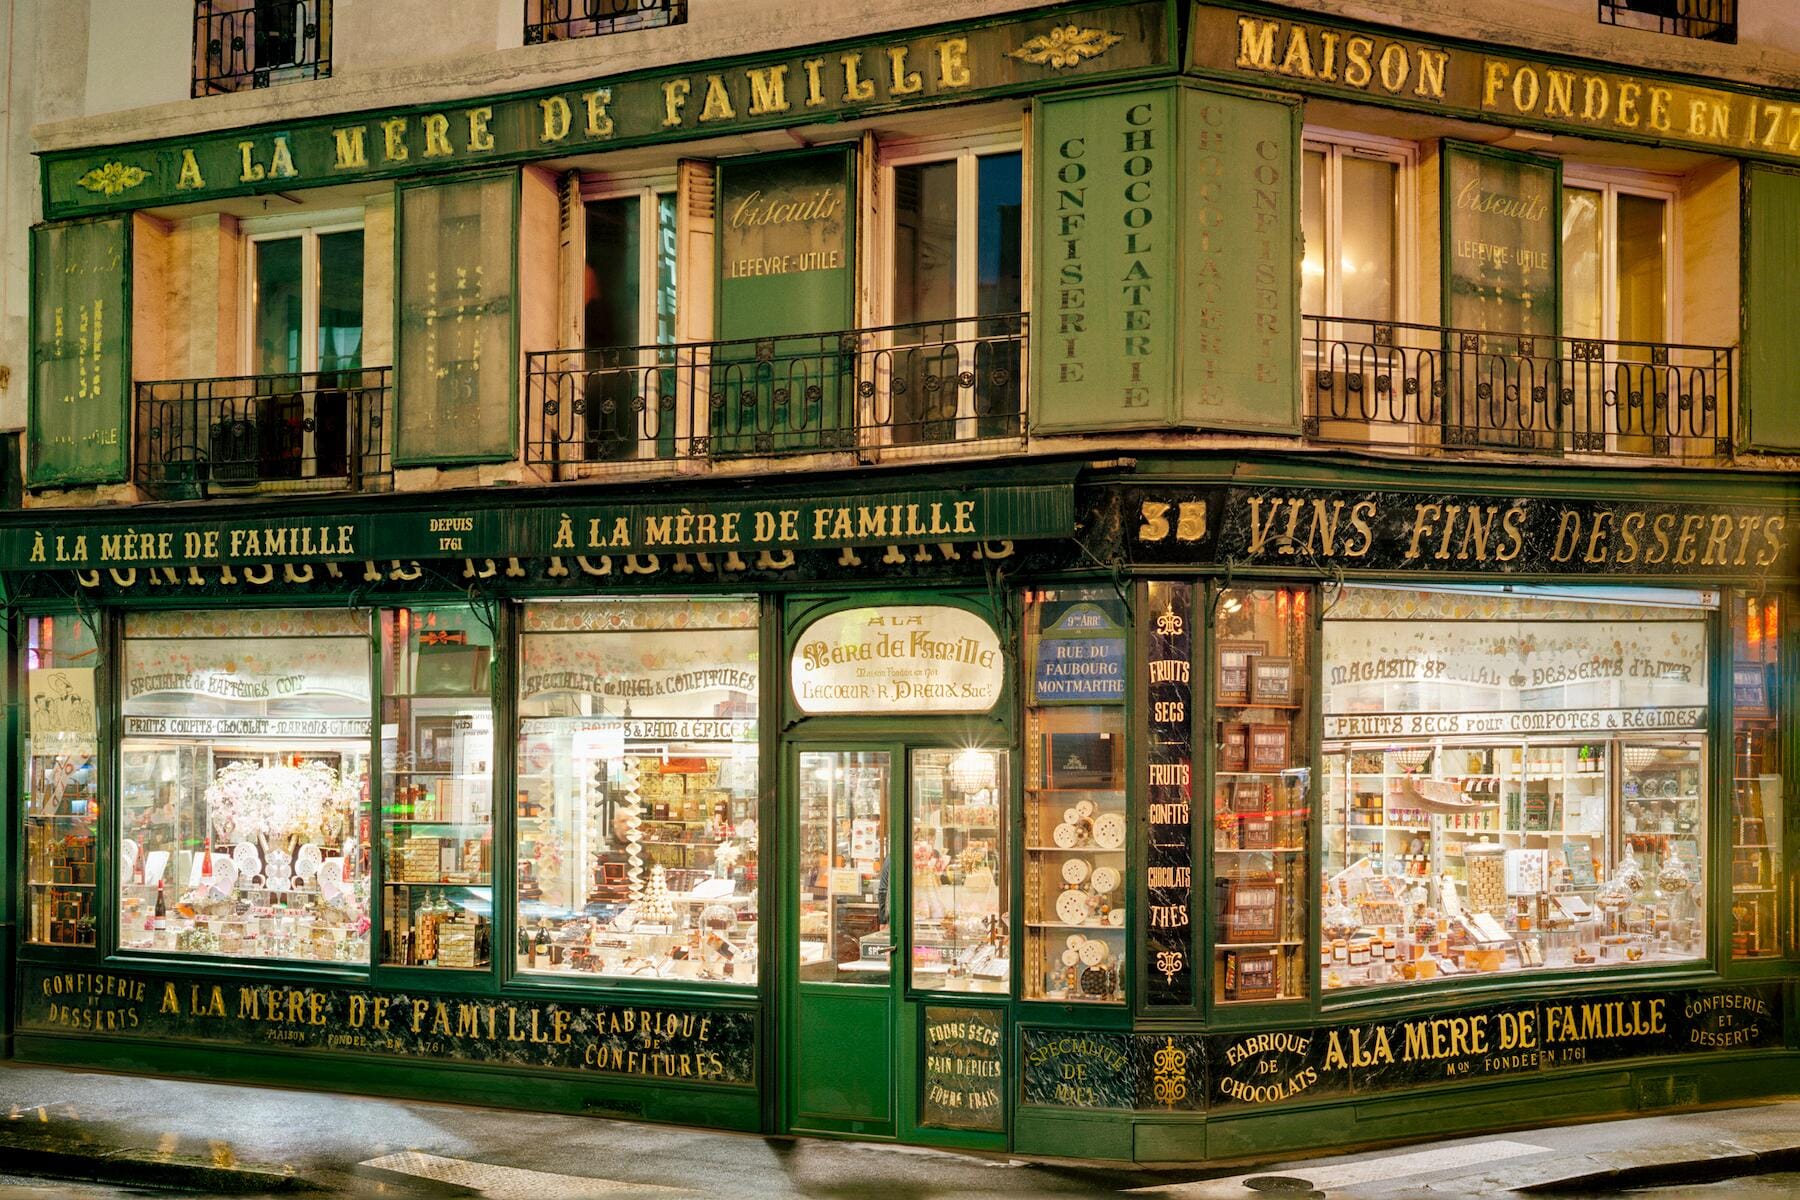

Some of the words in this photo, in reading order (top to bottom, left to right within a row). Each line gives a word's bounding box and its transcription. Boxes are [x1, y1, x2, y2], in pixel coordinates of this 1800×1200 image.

[1236, 17, 1449, 98] MAISON
[1688, 101, 1729, 138] EN
[176, 149, 205, 190] A
[239, 137, 298, 183] LA
[540, 88, 614, 143] DE
[662, 37, 970, 127] FAMILLE
[1057, 138, 1086, 384] CONFISERIE
[1120, 103, 1154, 409] CHOCOLATERIE
[429, 517, 474, 533] DEPUIS
[553, 513, 575, 548] À
[587, 517, 631, 547] LA
[645, 508, 740, 545] MÈRE
[754, 510, 799, 542] DE
[812, 501, 976, 539] FAMILLE
[1139, 501, 1207, 541] 35
[1247, 497, 1376, 556] VINS
[1405, 503, 1527, 561] FINS
[1550, 510, 1786, 566] DESSERTS
[30, 530, 46, 562] À
[56, 535, 88, 562] LA
[101, 527, 173, 561] MÈRE
[184, 531, 219, 559] DE
[229, 524, 355, 558] FAMILLE
[439, 537, 463, 551] 1761
[892, 616, 922, 625] LA
[877, 632, 904, 658] de
[1057, 646, 1082, 658] RUE
[1091, 646, 1109, 657] DU
[1046, 663, 1117, 675] FAUBOURG
[1148, 660, 1190, 684] FRUITS
[1331, 658, 1417, 686] MAGASIN
[1532, 658, 1623, 686] DESSERTS
[666, 669, 757, 694] CONFITURES
[1037, 680, 1125, 693] MONTMARTRE
[1155, 702, 1184, 722] SECS
[1337, 716, 1403, 735] FRUITS
[1412, 716, 1459, 733] SECS
[1511, 712, 1600, 730] COMPOTES
[1607, 714, 1618, 728] &
[1623, 708, 1697, 728] RÉGIMES
[1149, 765, 1189, 786] FRUITS
[1148, 866, 1190, 888] CHOCOLATS
[43, 973, 145, 1002] CONFISERIE
[49, 1002, 138, 1030] DESSERTS
[160, 982, 181, 1014] A
[190, 984, 227, 1017] LA
[349, 995, 390, 1029] DE
[410, 998, 572, 1044] FAMILLE
[1685, 995, 1765, 1018] CONFISERIE
[596, 1010, 712, 1042] FABRIQUE
[1718, 1015, 1733, 1027] ET
[644, 1039, 661, 1050] DE
[929, 1023, 965, 1043] FOURS
[968, 1024, 999, 1046] SECS
[1322, 1030, 1347, 1071] A
[1351, 1026, 1395, 1067] LA
[1403, 1014, 1488, 1061] MERE
[1499, 1010, 1536, 1050] DE
[1545, 999, 1667, 1042] FAMILLE
[1691, 1024, 1759, 1046] DESSERTS
[585, 1044, 724, 1077] CONFITURES
[1225, 1032, 1311, 1067] FABRIQUE
[1540, 1050, 1555, 1062] EN
[1563, 1047, 1586, 1060] 1761
[927, 1056, 951, 1074] PAIN
[1063, 1063, 1087, 1080] DE
[1260, 1060, 1278, 1074] DE
[1220, 1066, 1318, 1103] CHOCOLATS
[969, 1088, 999, 1109] FRAIS
